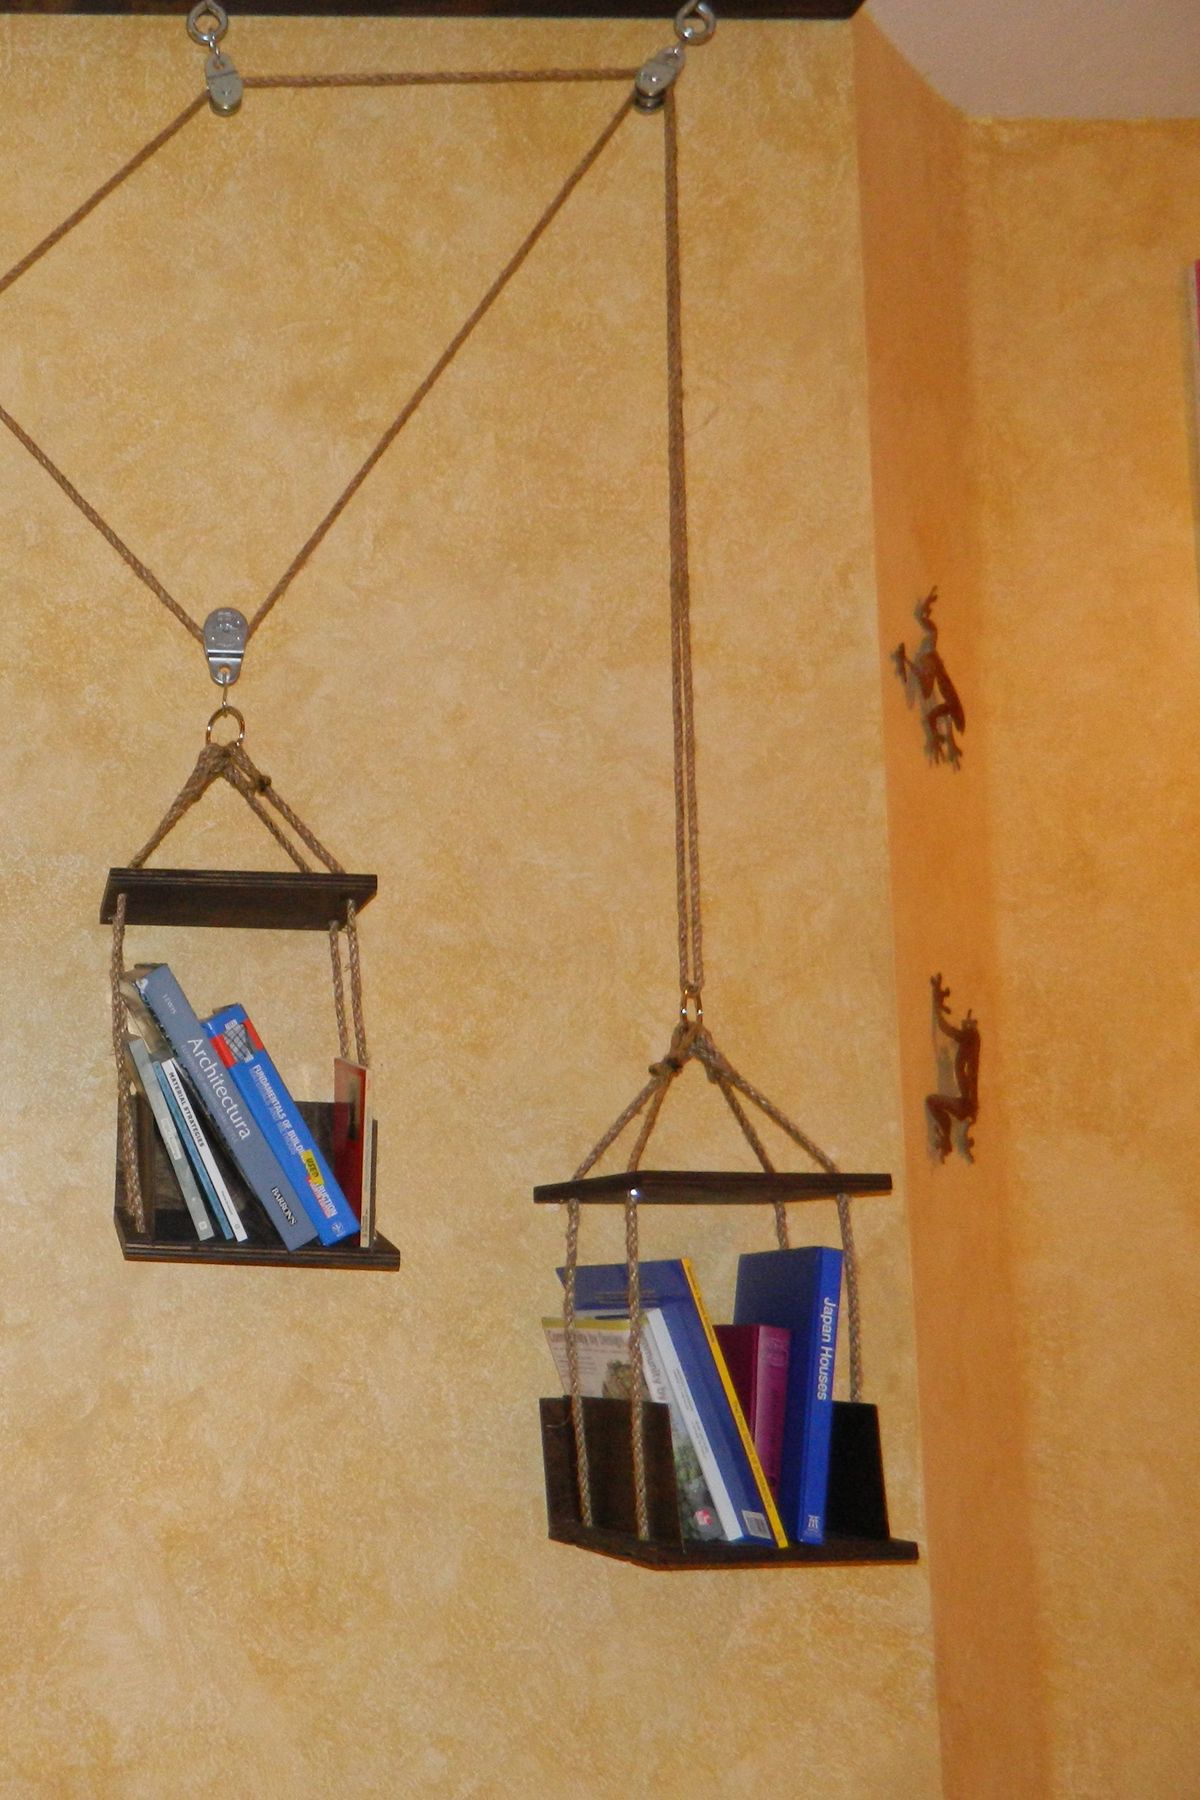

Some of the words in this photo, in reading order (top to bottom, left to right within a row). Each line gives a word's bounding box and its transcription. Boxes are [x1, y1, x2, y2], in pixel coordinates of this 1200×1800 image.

[168, 1072, 188, 1109] MATERIAL
[185, 1110, 205, 1148] STRATEGIES
[187, 1038, 251, 1141] Architectura
[253, 1064, 287, 1122] FUNDAMENTALS
[282, 1117, 292, 1134] OF
[306, 1156, 318, 1179] USED
[271, 1187, 297, 1226] BARRON'S
[821, 1296, 837, 1343] Japan
[817, 1347, 833, 1400] Houses
